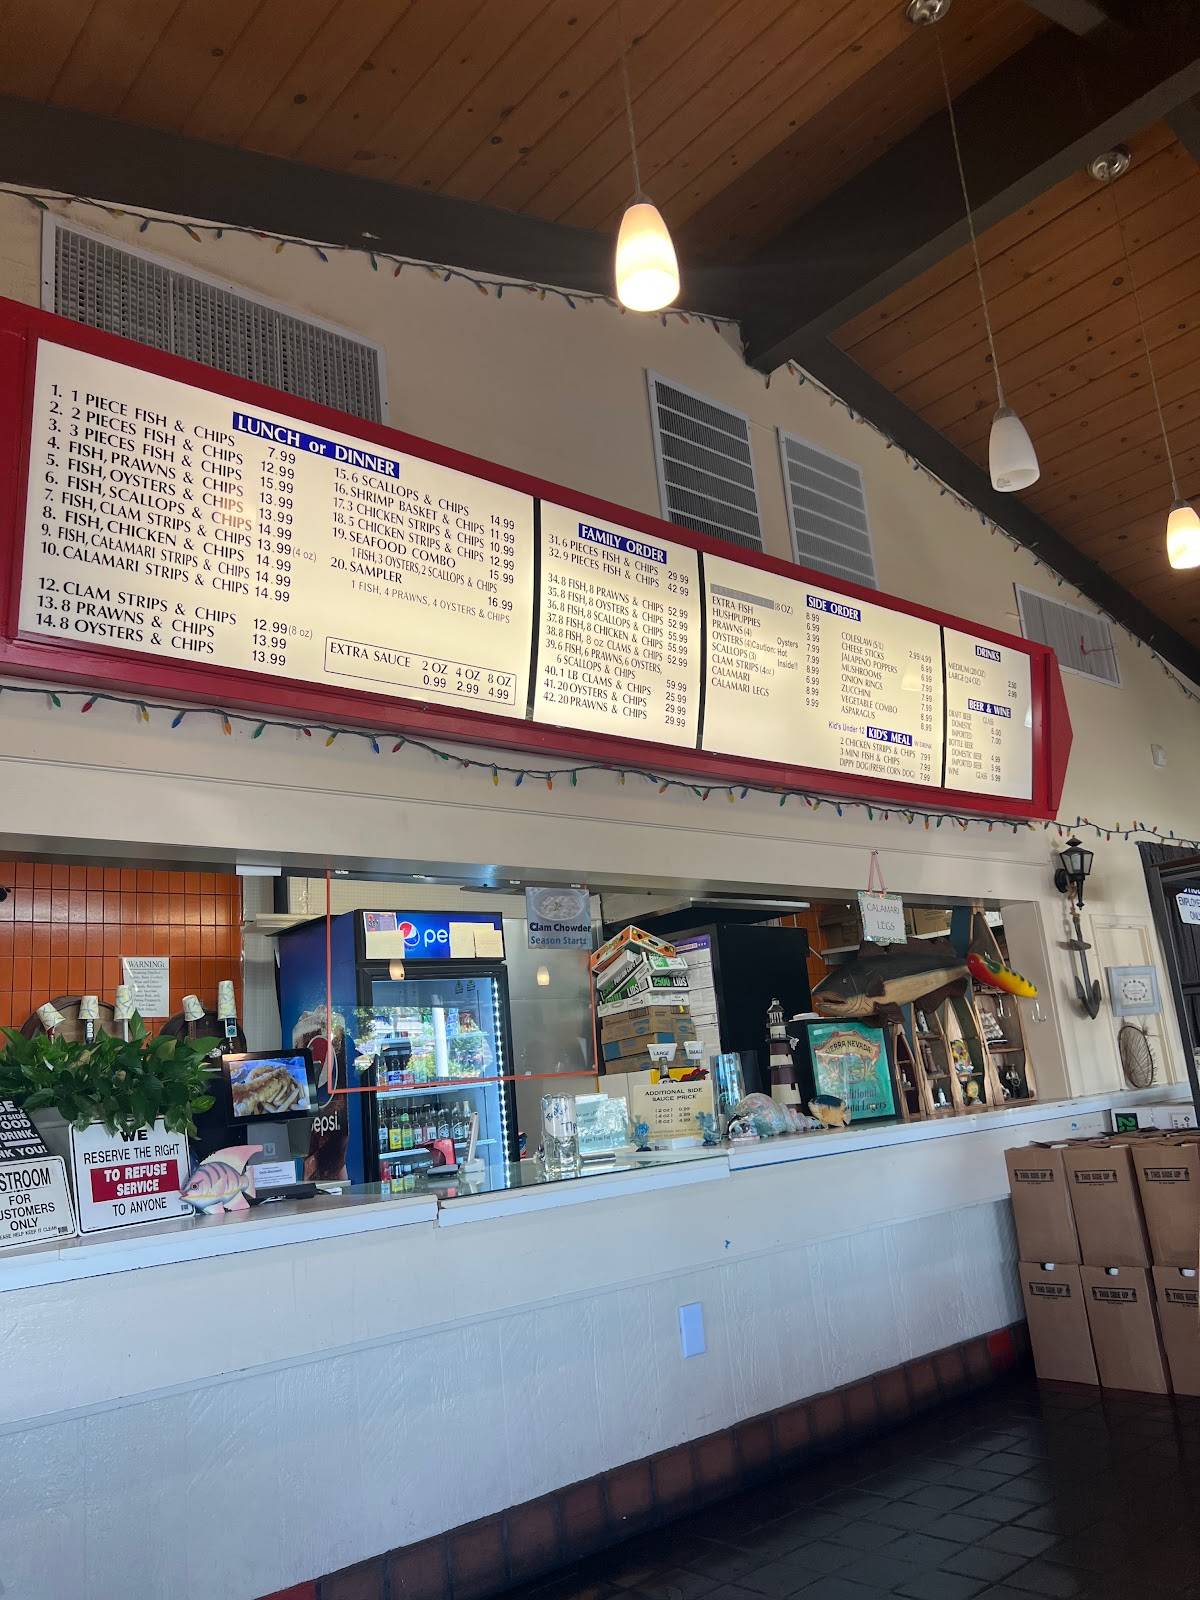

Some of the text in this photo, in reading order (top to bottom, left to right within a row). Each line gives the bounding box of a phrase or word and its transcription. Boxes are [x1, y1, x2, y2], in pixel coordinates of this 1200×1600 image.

[51, 383, 295, 464] 1. 1 PIECE FISH & CHIPS 7.99
[50, 400, 294, 479] 2. 2 PIECES FISH & CHIPS 12.99
[238, 416, 395, 476] LUNCH or DINNER
[335, 467, 514, 530] 15. 6 SCALLOPS & CHIPS 14.99
[582, 526, 664, 562] FAMILY ORDER
[332, 526, 513, 584] 19. SEAFOOD COMBO 15.99
[549, 534, 688, 584] 31. 6 PIECES FISH & CHIPS 29.99
[41, 541, 289, 603] 10. CALAMARI STRIPS & CHIPS 14.99
[808, 597, 859, 620] SIDE ORDER
[36, 612, 286, 666] 14. 8 OYSTERS & CHIPS 13.99
[977, 647, 999, 660] DRINKS
[330, 642, 510, 687] EXTRA SAUCE 2 OZ 4 OZ 8 OZ
[423, 674, 508, 700] 0.99 2.99 4.99
[544, 664, 686, 704] 40. 1 LB CLAMS & CHIPS 25.99
[970, 701, 1010, 718] BEER & WINE
[869, 728, 888, 741] KID'S
[890, 732, 912, 745] MEAL
[530, 923, 591, 932] Clam Chowder
[531, 936, 561, 944] Season
[627, 984, 639, 996] LIDS
[673, 977, 687, 986] LIDS
[848, 1041, 872, 1053] NEVADA
[312, 1111, 338, 1136] epsi
[120, 1130, 148, 1142] WE
[16, 1145, 48, 1155] YOU!
[84, 1144, 179, 1164] RESERVE THE RIGHT
[104, 1163, 167, 1182] TO REFUSE
[117, 1179, 159, 1196] SERVICE
[9, 1194, 31, 1205] FOR
[113, 1197, 167, 1216] TO ANYONE
[10, 1217, 38, 1231] ONLY
